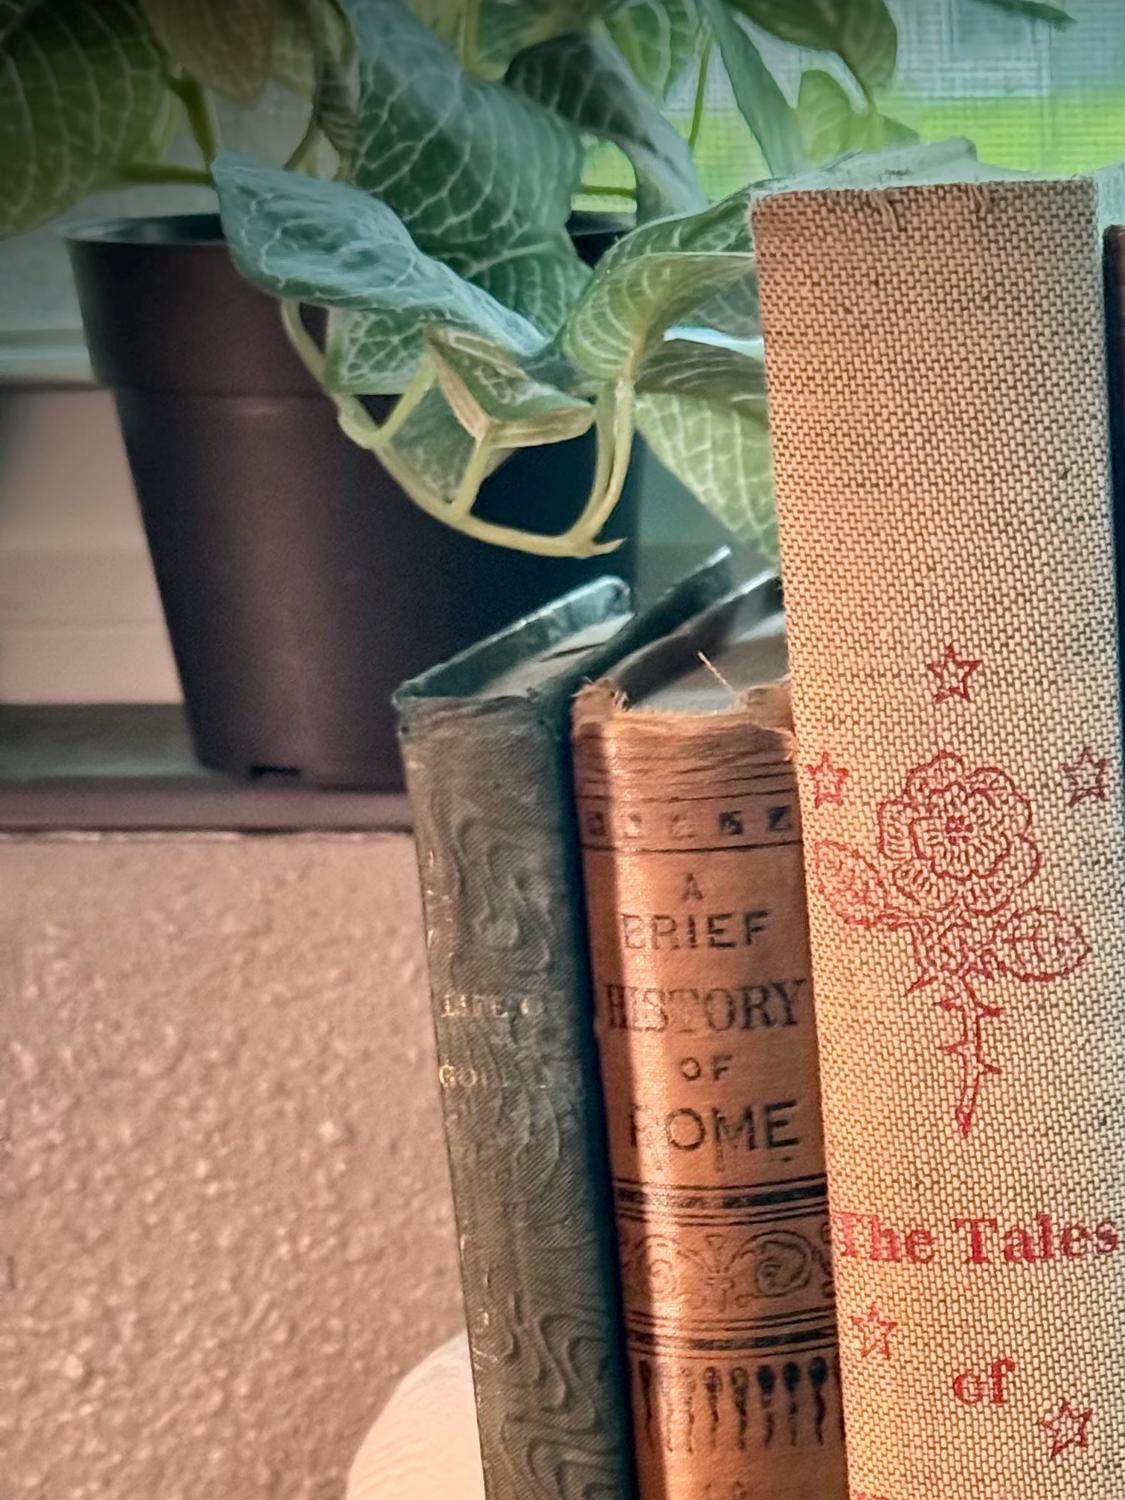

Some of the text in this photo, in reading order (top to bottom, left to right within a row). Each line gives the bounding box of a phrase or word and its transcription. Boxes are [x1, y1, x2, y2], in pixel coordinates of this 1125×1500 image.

[682, 872, 705, 900] A
[620, 909, 770, 950] BRIEF
[604, 979, 808, 1034] HISTORY
[680, 1055, 734, 1083] OF
[832, 1211, 1119, 1264] The Tales
[951, 1357, 1017, 1405] of
